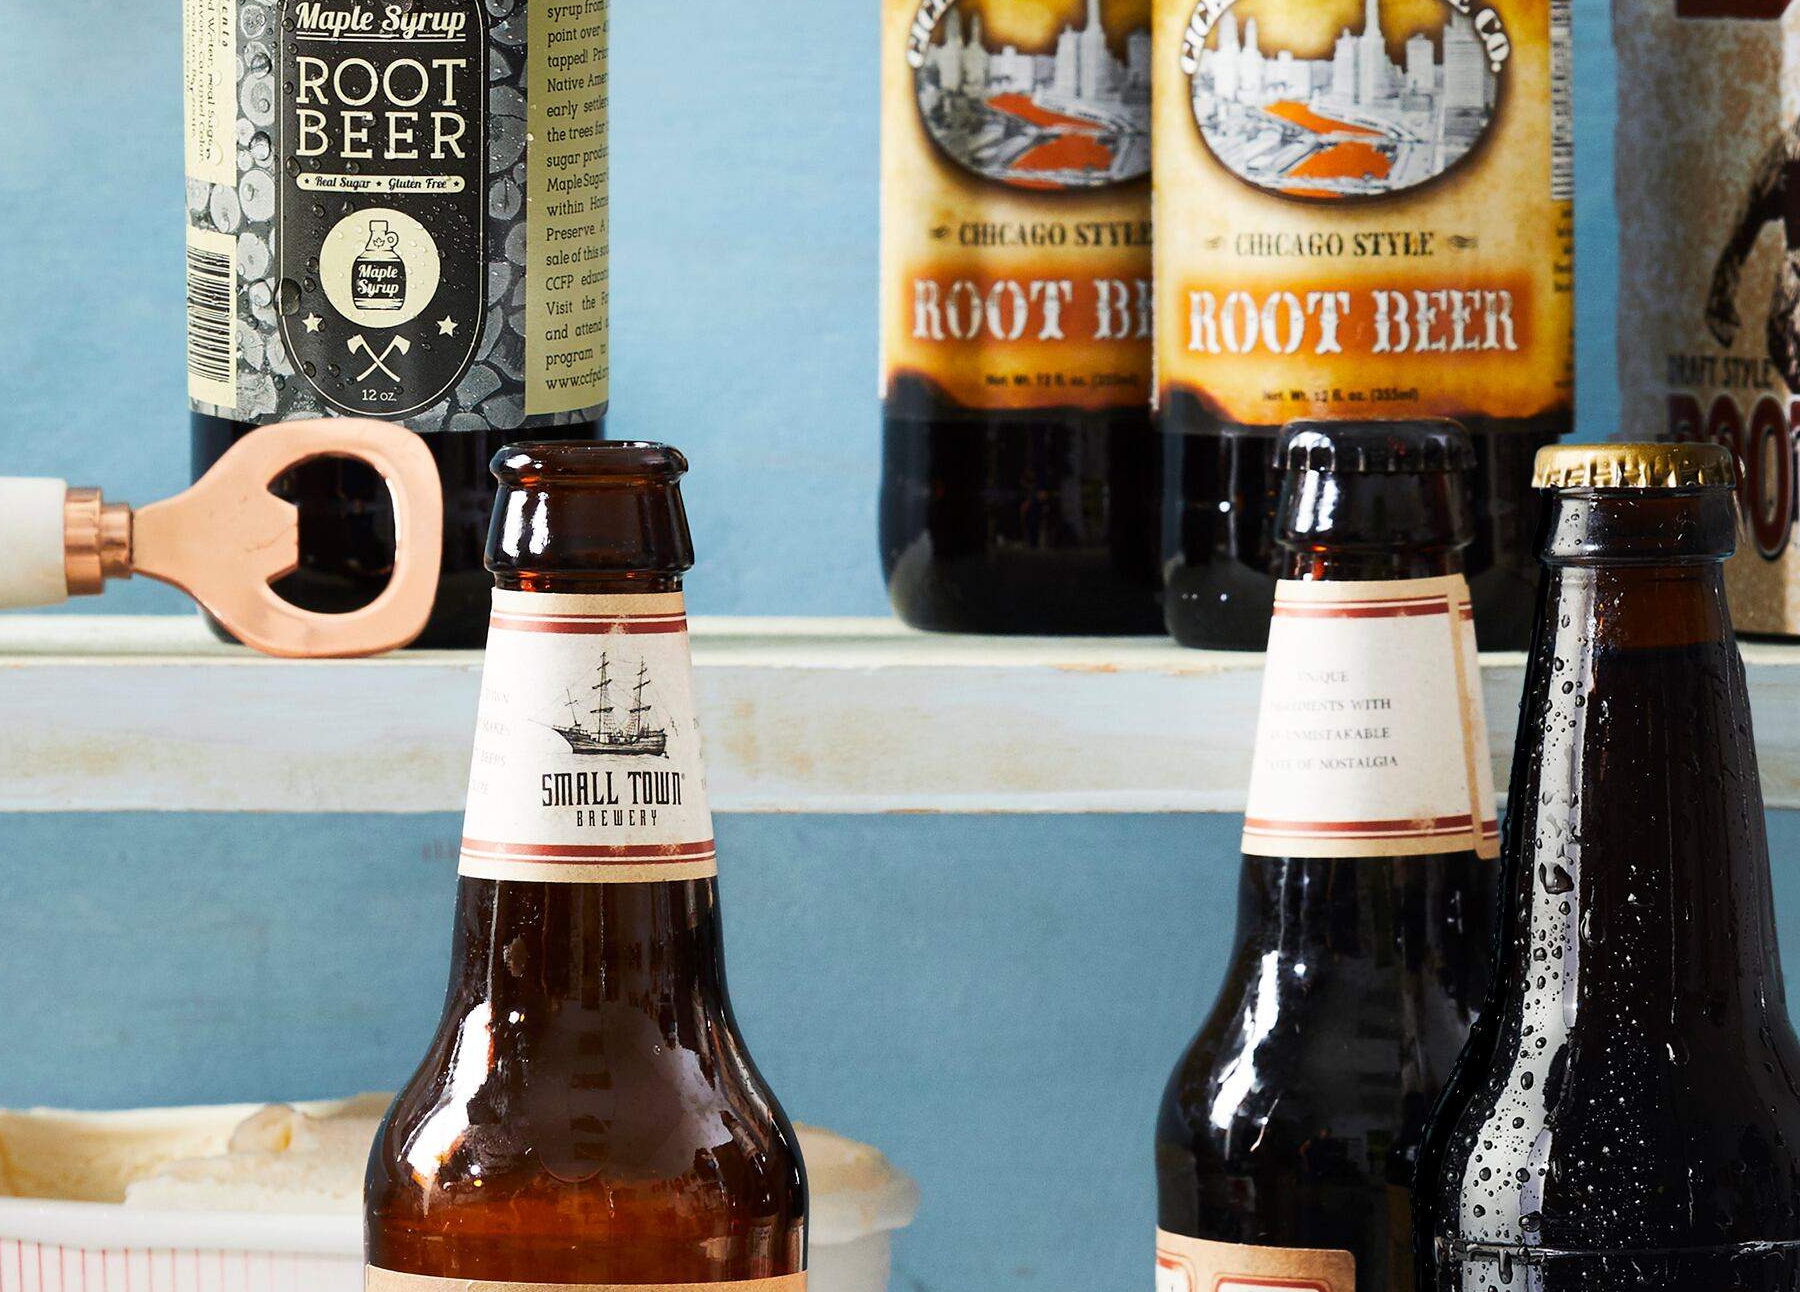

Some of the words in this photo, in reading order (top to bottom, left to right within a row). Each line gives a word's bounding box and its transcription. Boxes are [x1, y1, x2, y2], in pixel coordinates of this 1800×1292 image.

[296, 2, 373, 38] Maple
[382, 4, 466, 39] Syrup
[548, 29, 577, 48] point
[1473, 8, 1511, 73] CO.
[296, 57, 466, 106] ROOT
[296, 109, 466, 159] BEER
[315, 176, 336, 187] Real
[340, 177, 371, 190] Sugar
[388, 178, 422, 190] Gluten
[425, 178, 447, 189] Free
[958, 221, 1067, 247] CHICAGO
[1235, 231, 1344, 256] CHICAGO
[1352, 232, 1435, 257] STYLE
[358, 264, 398, 281] Maple
[546, 275, 574, 290] CCFP
[357, 279, 399, 297] Syrup
[546, 300, 573, 316] Visit
[911, 278, 1072, 341] ROOT
[1187, 288, 1351, 355] ROOT
[1372, 288, 1518, 354] BEER
[546, 347, 593, 370] program
[362, 389, 376, 401] 12
[542, 771, 619, 807] SMALL
[628, 771, 682, 805] TOWN
[577, 809, 657, 827] BREWERY
